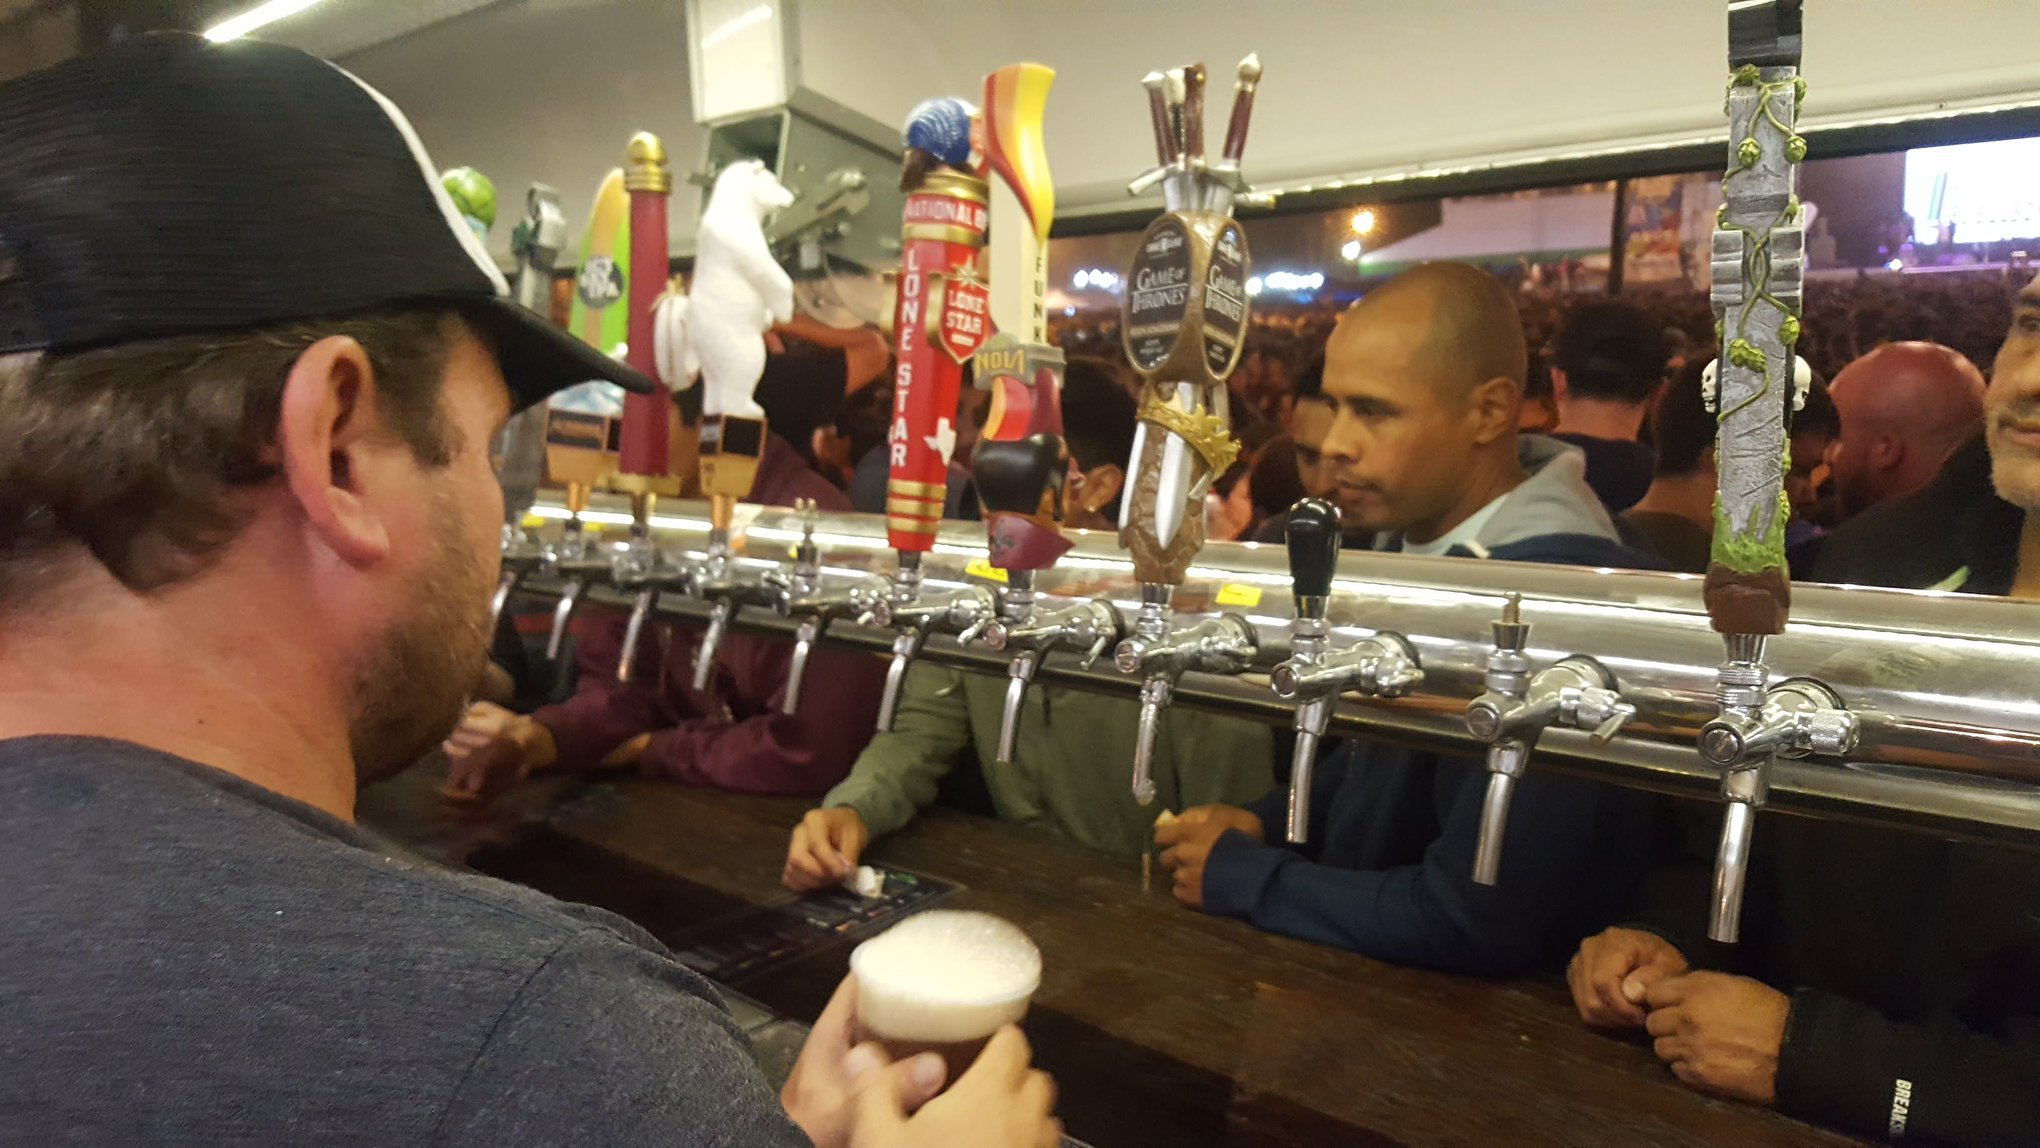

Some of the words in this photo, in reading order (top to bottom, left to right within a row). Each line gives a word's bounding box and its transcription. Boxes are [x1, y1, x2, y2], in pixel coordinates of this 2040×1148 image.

[1137, 266, 1175, 291] GAME
[901, 248, 920, 351] LONE
[948, 289, 984, 315] LONE
[1131, 283, 1188, 314] THRONES
[946, 311, 982, 335] STAR
[975, 349, 1024, 378] NOLA
[890, 363, 912, 467] STAR
